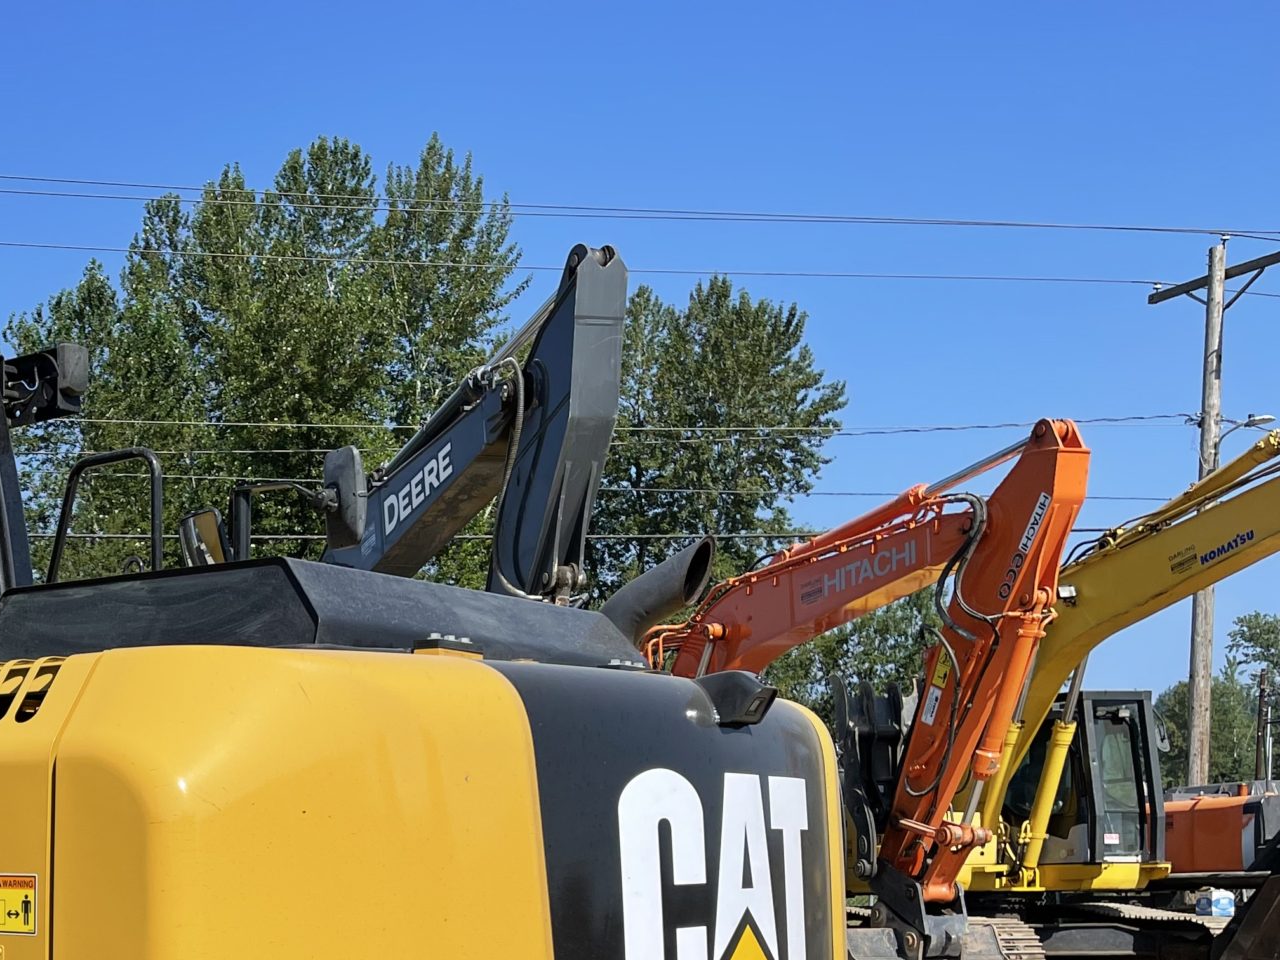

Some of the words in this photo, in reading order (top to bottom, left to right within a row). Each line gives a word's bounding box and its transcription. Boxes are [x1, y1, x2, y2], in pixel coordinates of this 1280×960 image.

[383, 442, 453, 536] DEERE
[1021, 494, 1050, 553] HITACHI
[1200, 529, 1255, 565] KOMATSU
[823, 540, 917, 597] HITACHI
[2, 879, 34, 889] WARNING
